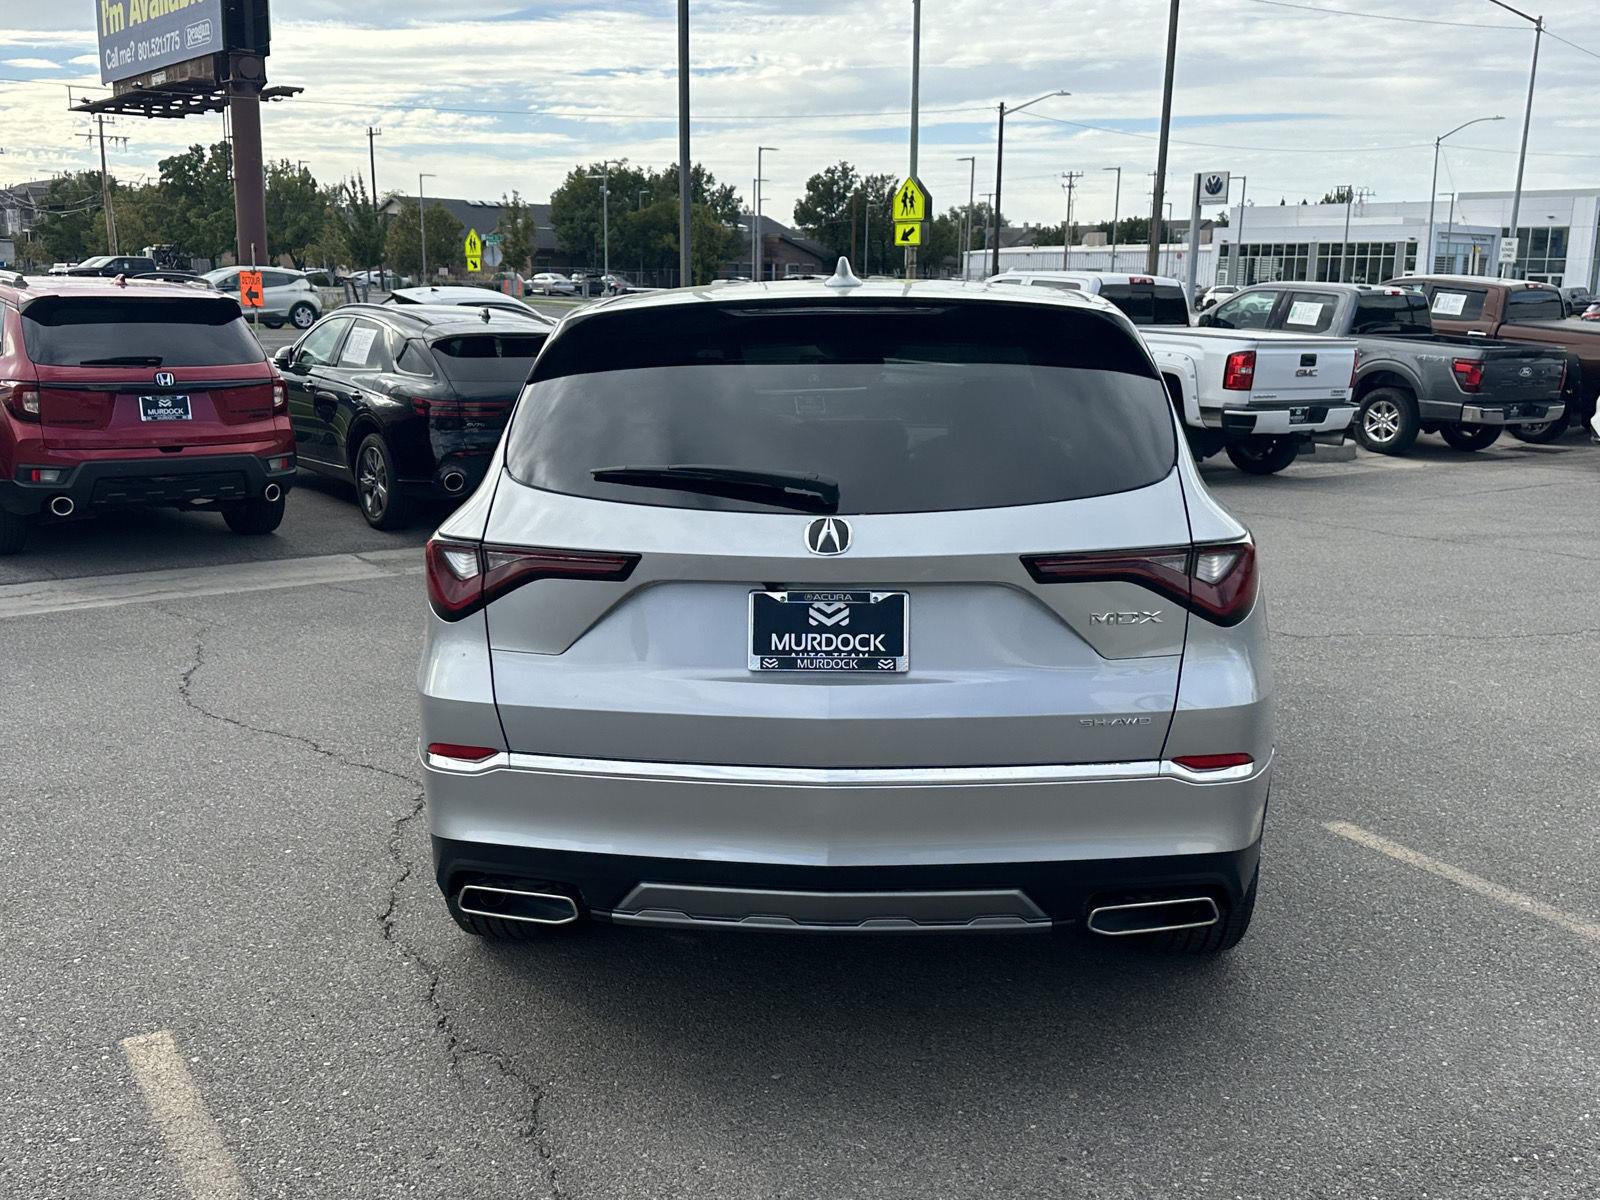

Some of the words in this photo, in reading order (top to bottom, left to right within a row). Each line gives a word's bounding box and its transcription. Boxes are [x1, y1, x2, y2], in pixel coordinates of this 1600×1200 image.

[187, 23, 211, 46] Reagan
[105, 46, 120, 70] Call
[120, 41, 135, 64] me?
[138, 30, 181, 61] 801.521.1775
[1296, 369, 1318, 377] GMC
[1089, 610, 1163, 625] MDX
[771, 633, 886, 652] MURDOCK
[797, 659, 858, 669] MURDOCK
